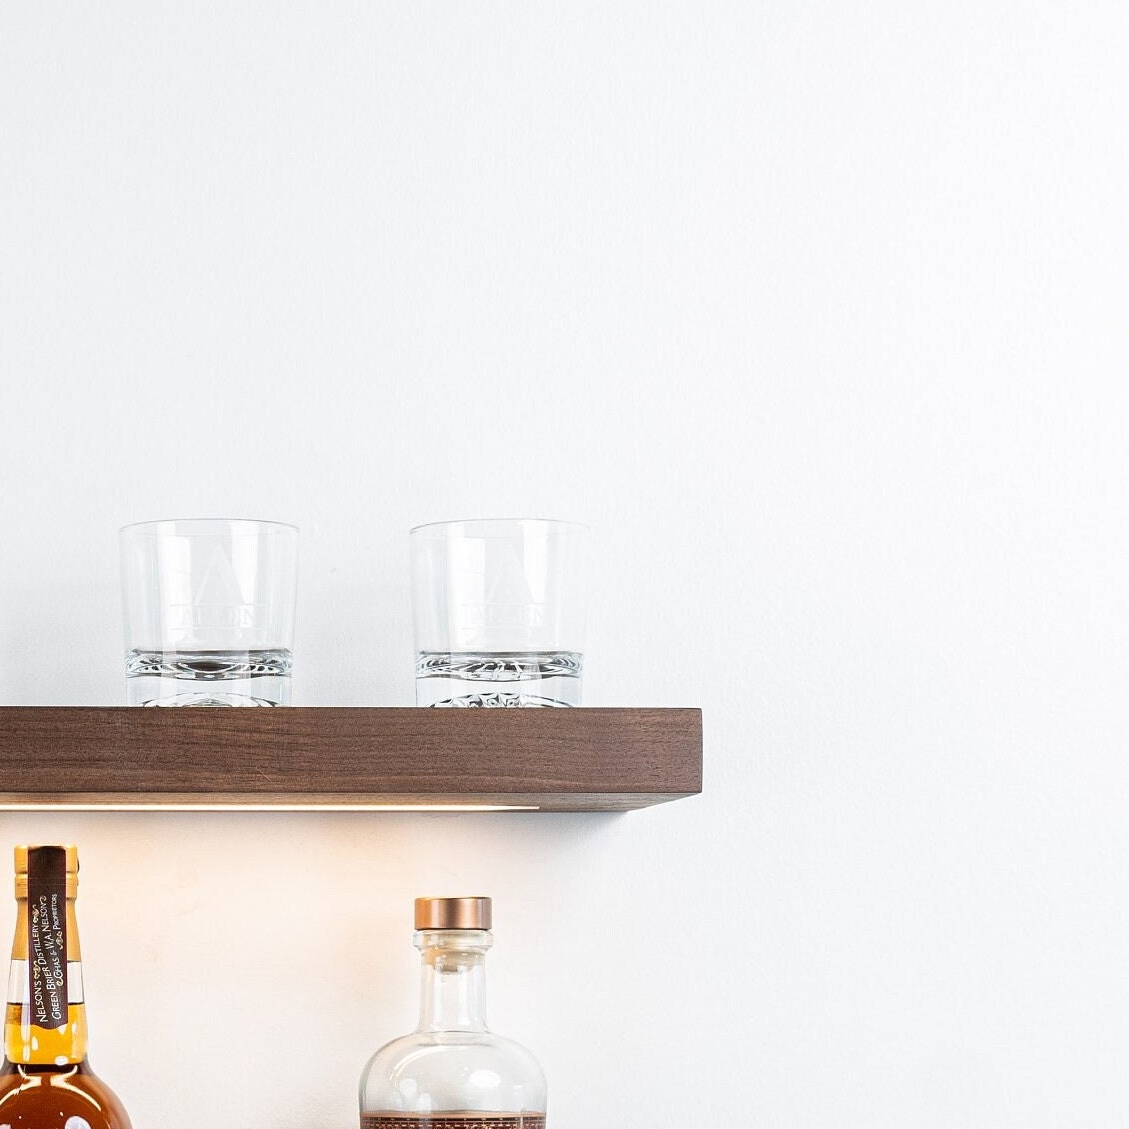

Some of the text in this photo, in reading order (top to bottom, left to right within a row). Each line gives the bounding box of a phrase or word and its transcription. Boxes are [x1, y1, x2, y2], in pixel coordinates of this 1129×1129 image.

[40, 901, 51, 932] NELSON
[32, 924, 62, 1020] GREEN BRIER DISTILLERY
[34, 980, 48, 1022] NELSON'S
